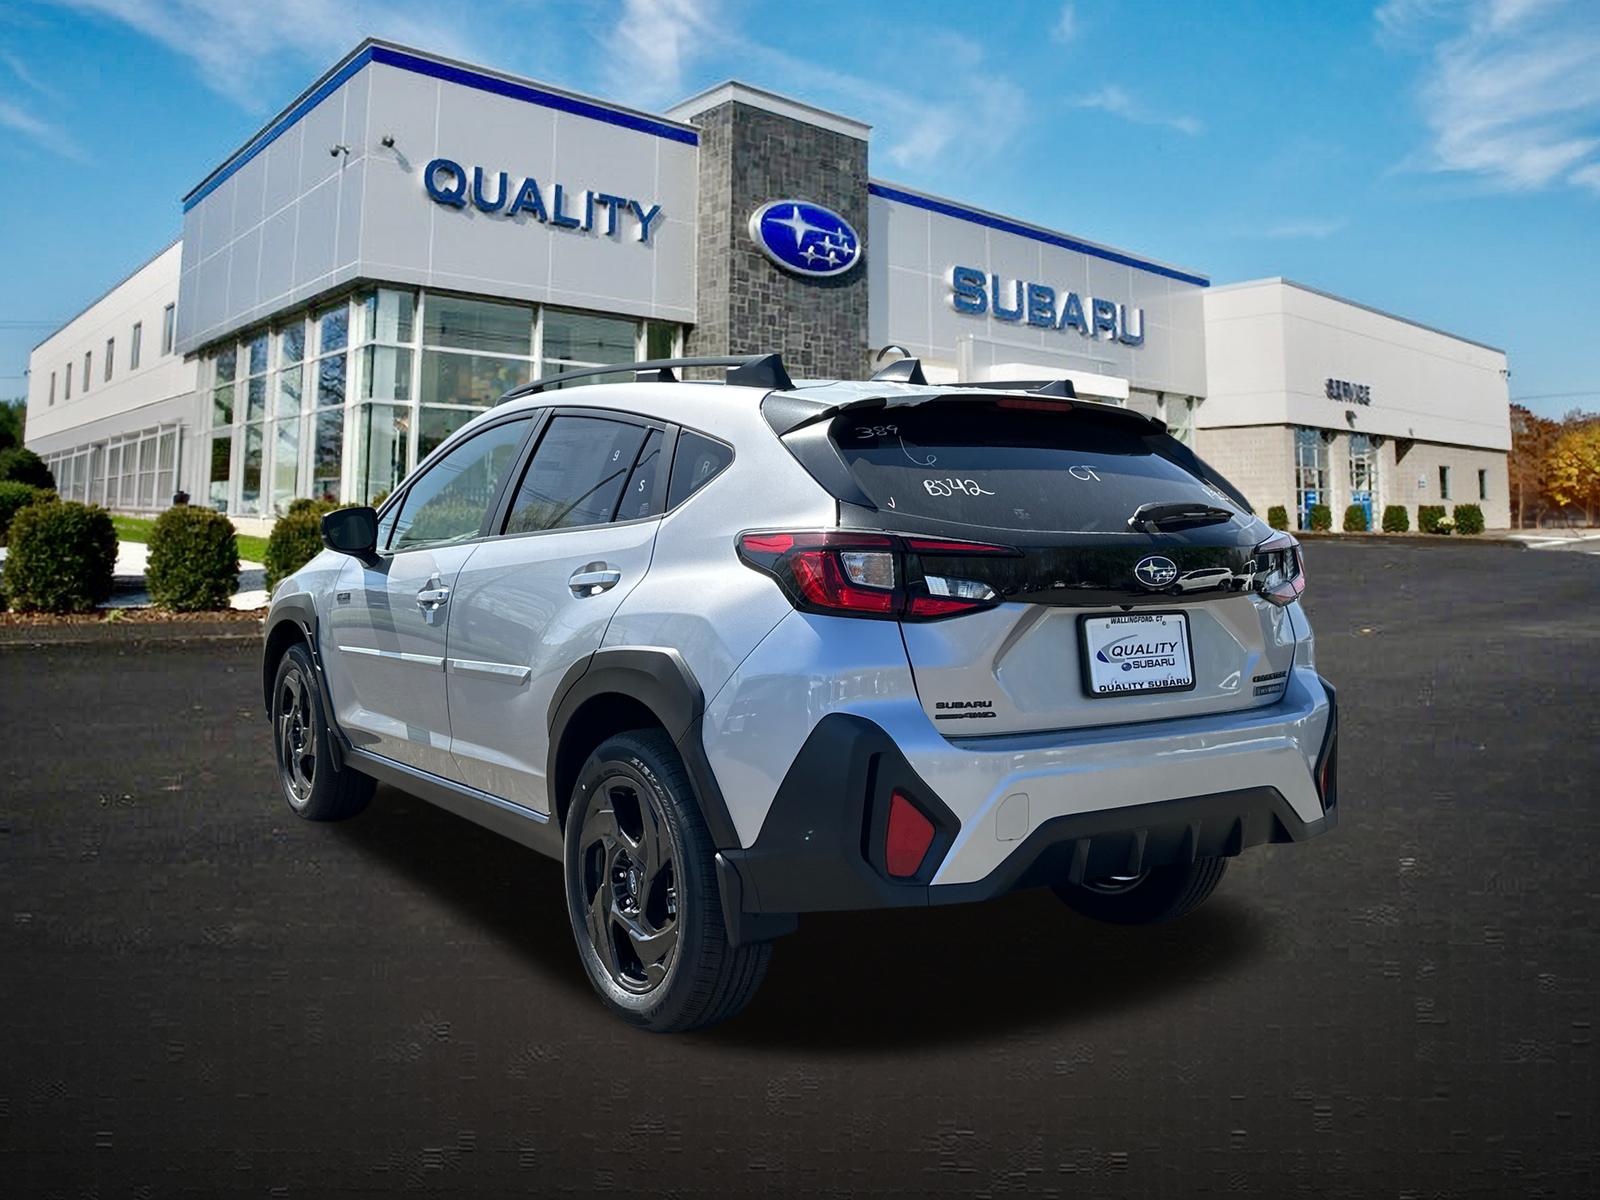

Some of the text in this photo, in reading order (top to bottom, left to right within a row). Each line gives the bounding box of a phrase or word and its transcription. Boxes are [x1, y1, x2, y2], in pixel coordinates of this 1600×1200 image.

[424, 158, 661, 243] QUALITY
[952, 266, 1144, 346] SUBARU
[1325, 377, 1371, 406] SERVICE
[1112, 642, 1178, 657] QUALITY
[1132, 658, 1175, 669] SUBARU
[1099, 678, 1190, 692] QUALITY SUBARU
[936, 701, 992, 709] SUBARU
